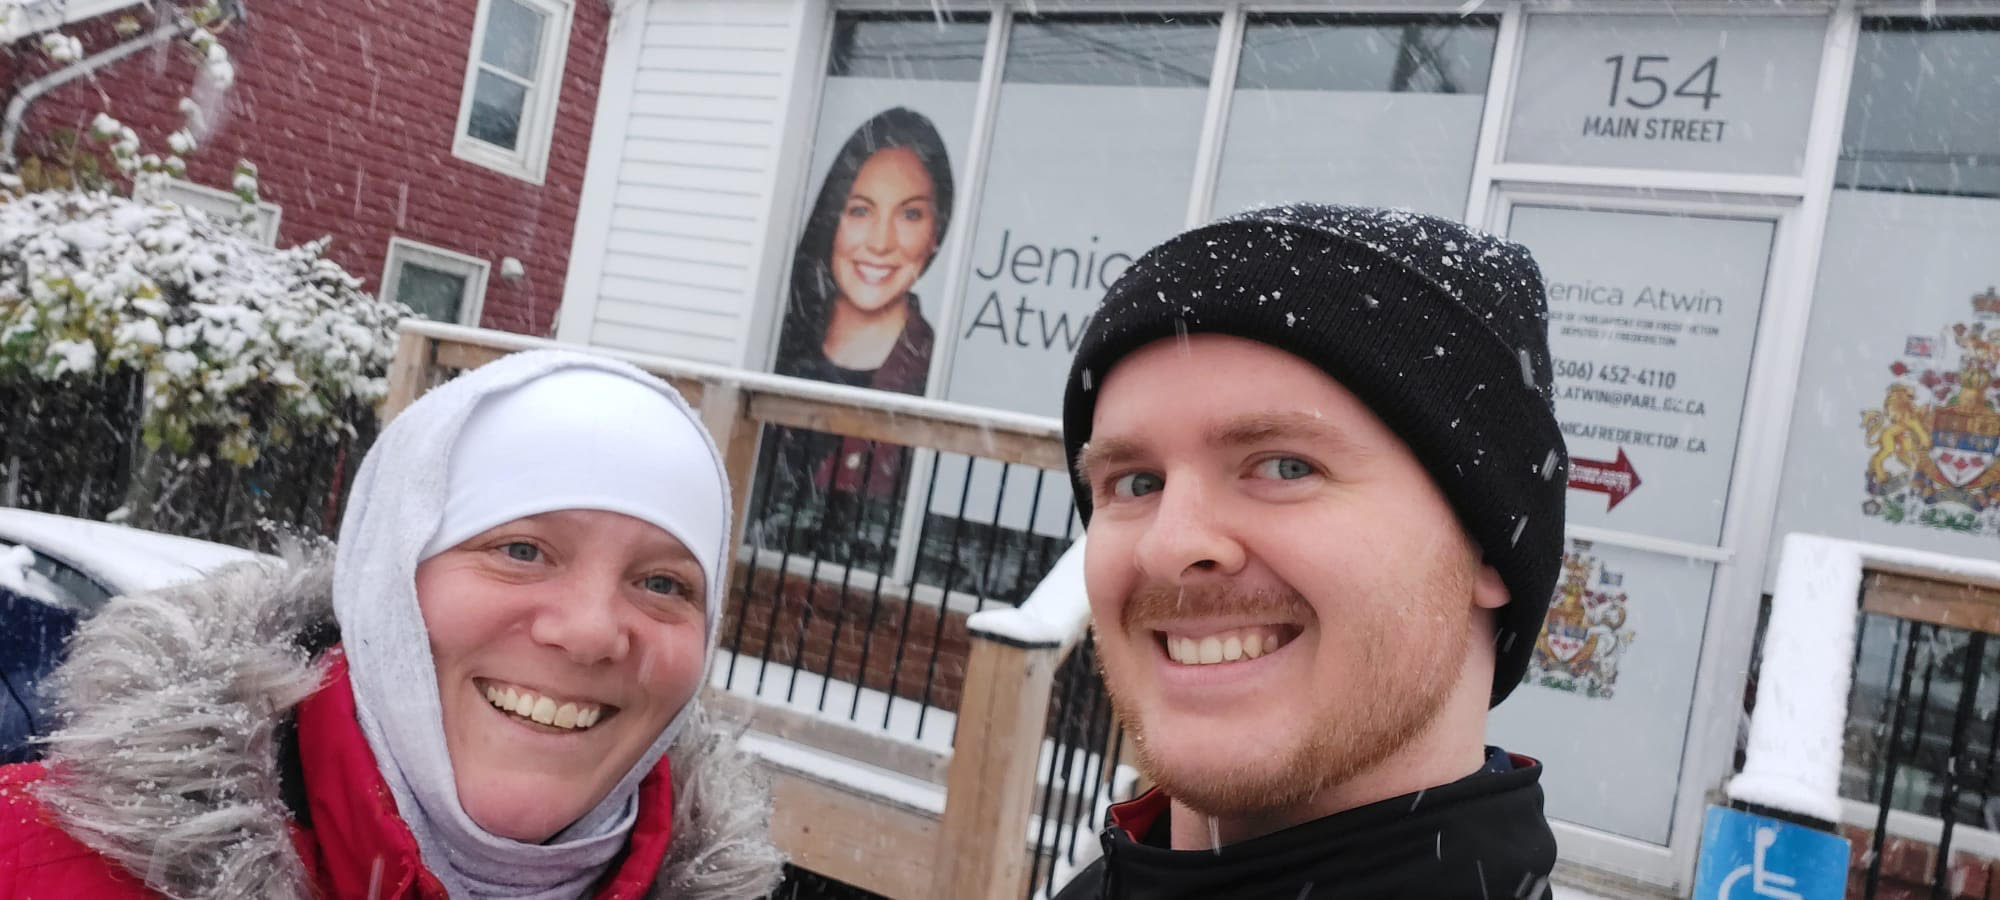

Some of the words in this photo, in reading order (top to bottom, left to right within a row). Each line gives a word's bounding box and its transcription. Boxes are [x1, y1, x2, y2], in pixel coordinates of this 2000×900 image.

[1605, 55, 1722, 110] 154
[1582, 115, 1640, 139] MAIN
[1643, 117, 1728, 143] STREET
[975, 229, 1134, 291] Jenic
[1544, 278, 1623, 306] enica
[1633, 285, 1722, 315] Atwin
[964, 290, 1092, 353] Atw
[1552, 359, 1593, 382] (506)
[1599, 364, 1677, 390] 452-4110
